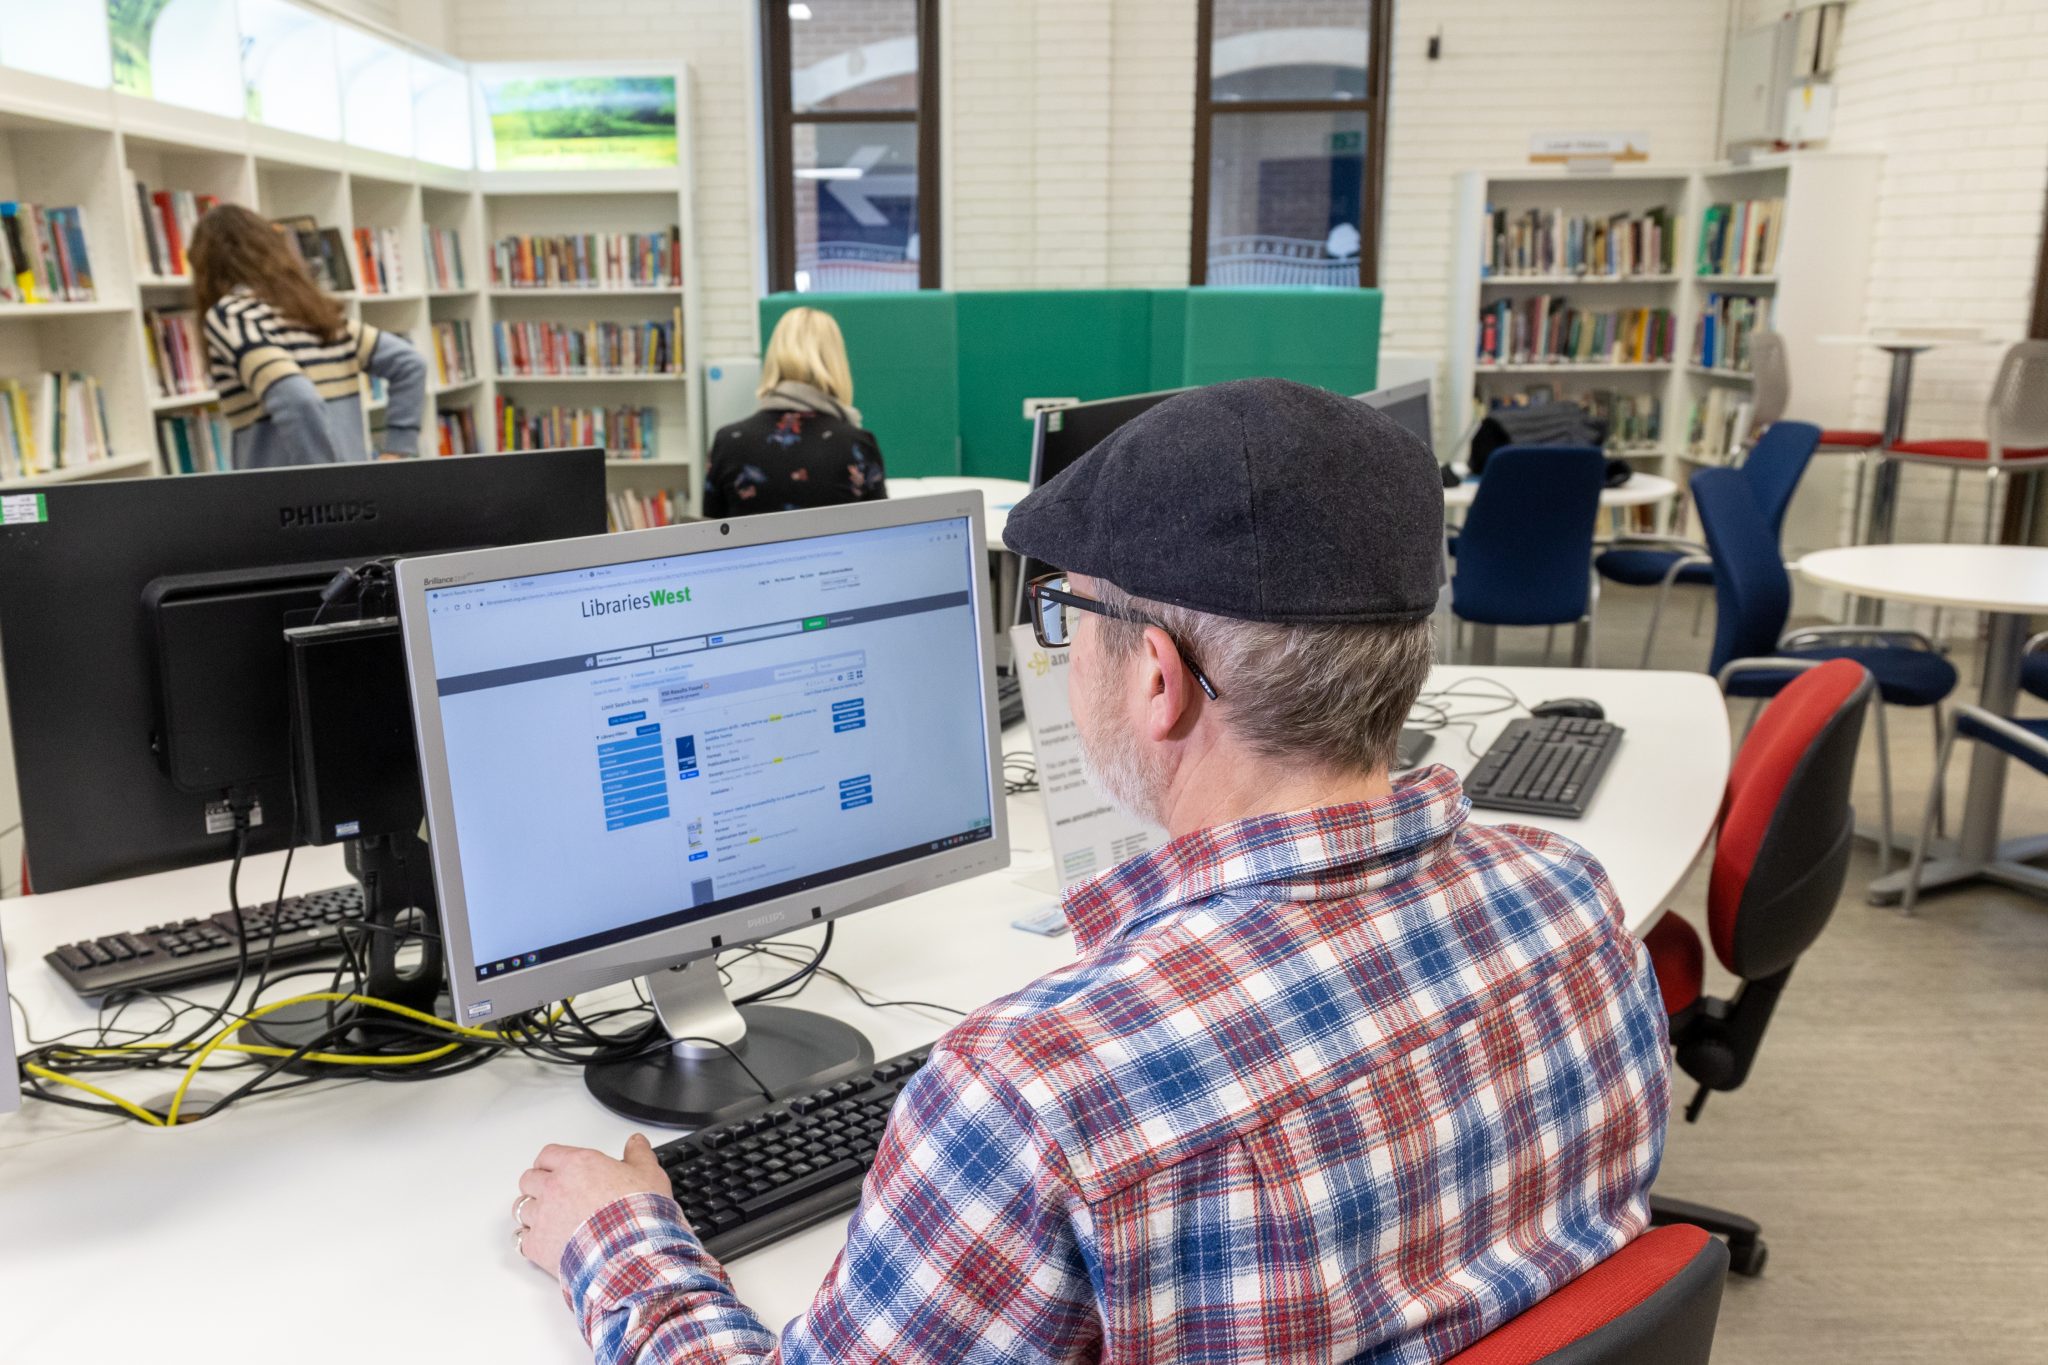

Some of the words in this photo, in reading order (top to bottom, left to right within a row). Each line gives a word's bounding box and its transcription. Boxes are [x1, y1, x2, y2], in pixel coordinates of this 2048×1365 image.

[279, 501, 379, 529] PHILIPS
[423, 576, 454, 586] Brilliance
[581, 585, 692, 619] LibrariesWest
[747, 911, 786, 929] PHILIPS
